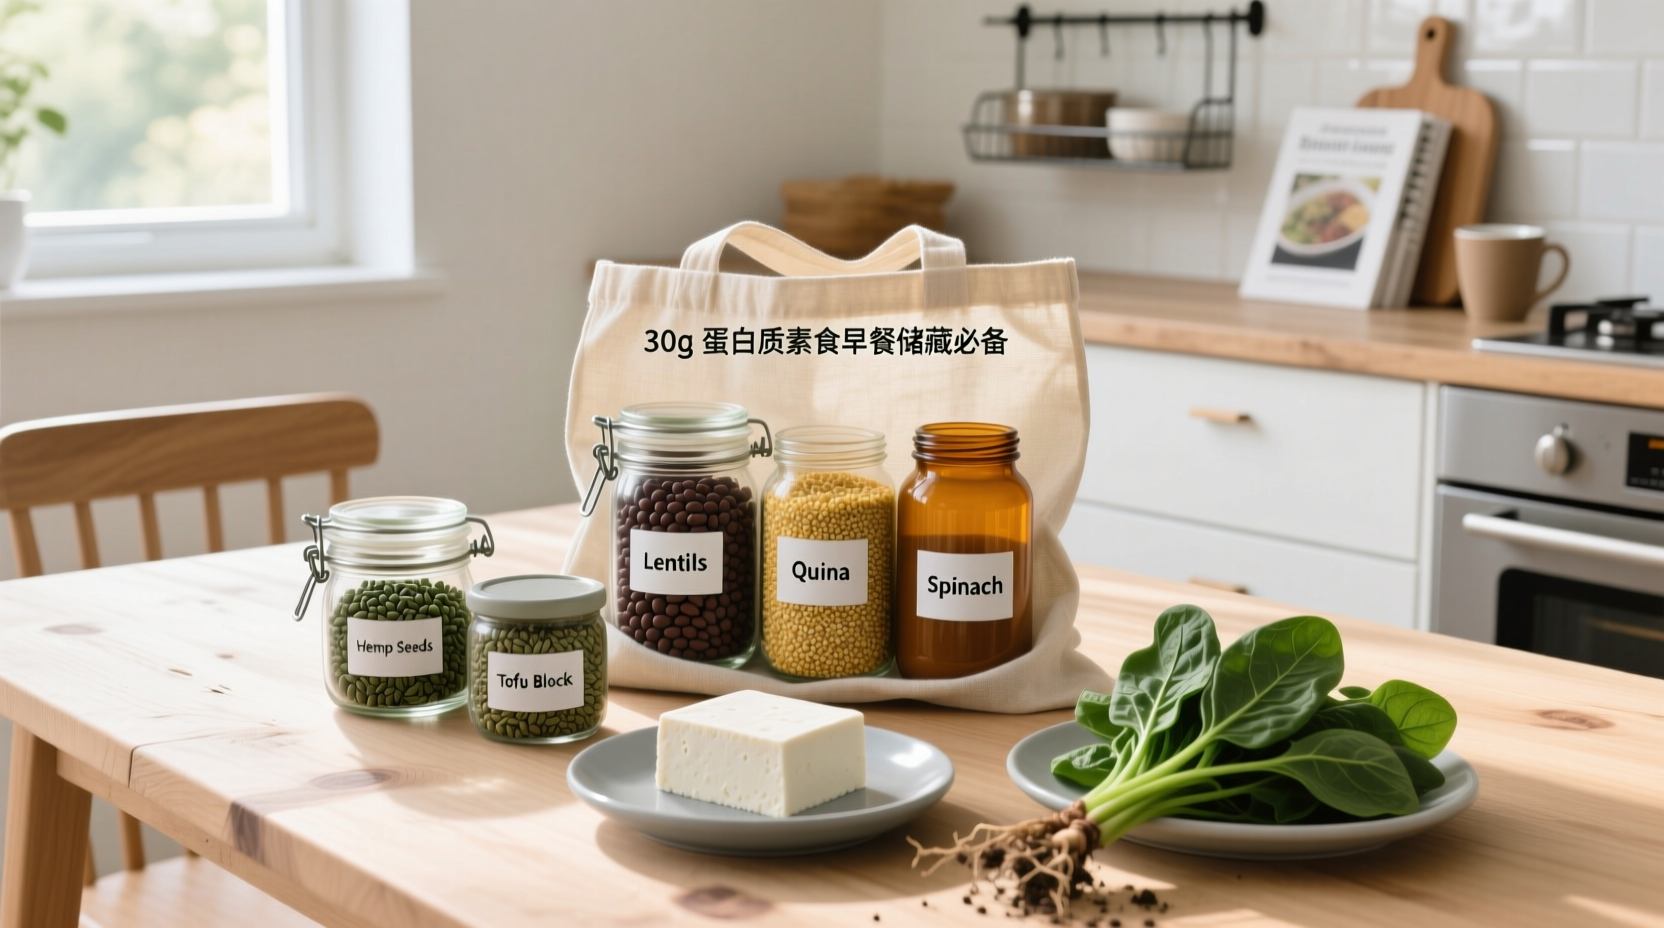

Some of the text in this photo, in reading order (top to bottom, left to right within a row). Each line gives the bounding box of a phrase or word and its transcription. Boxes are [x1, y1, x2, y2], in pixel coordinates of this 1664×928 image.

[643, 326, 1009, 360] 30g 蛋白质素食早餐储藏必备
[643, 551, 708, 572] Lentils
[791, 560, 850, 583] Quina
[927, 575, 1003, 600] Spinach
[356, 638, 434, 658] Hemp Seeds
[496, 671, 574, 690] Tofu Block
